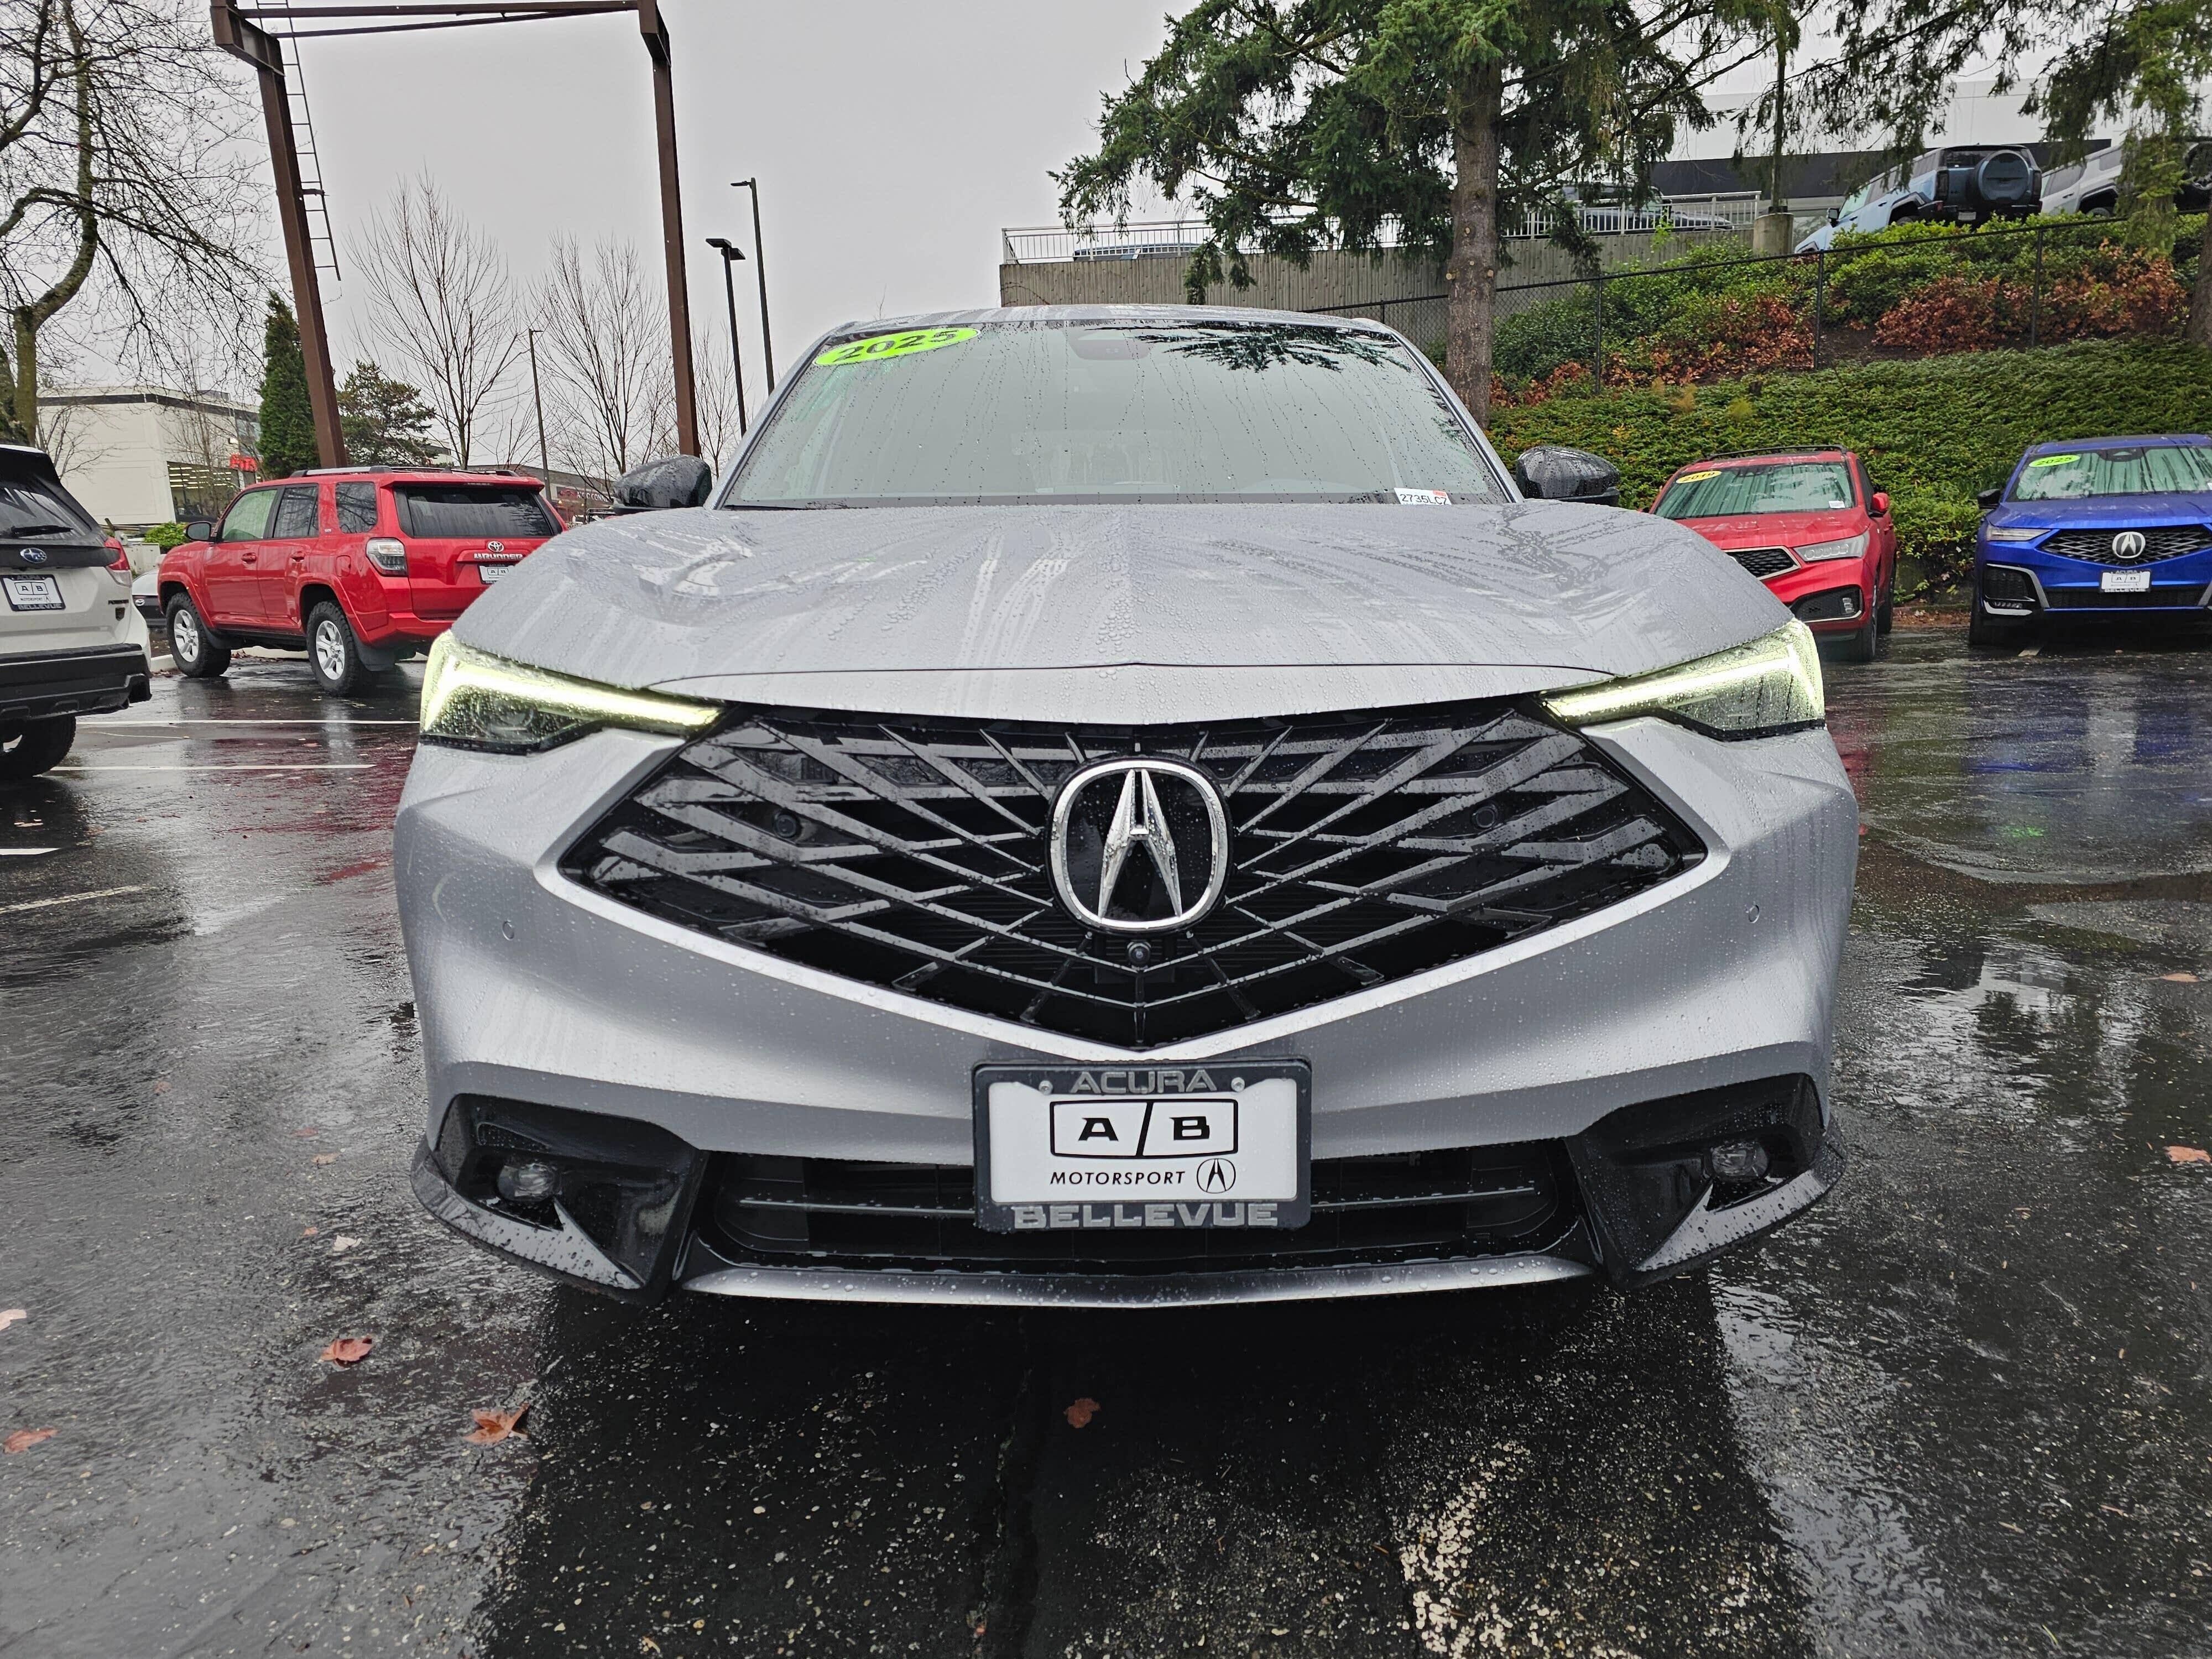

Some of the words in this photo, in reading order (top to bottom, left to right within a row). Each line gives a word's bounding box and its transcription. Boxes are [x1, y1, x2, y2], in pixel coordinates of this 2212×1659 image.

[833, 330, 959, 363] 2025
[1070, 1069, 1217, 1094] ACURA
[1050, 1171, 1185, 1186] MOTORSPORT
[1011, 1202, 1278, 1230] BELLEVUE
